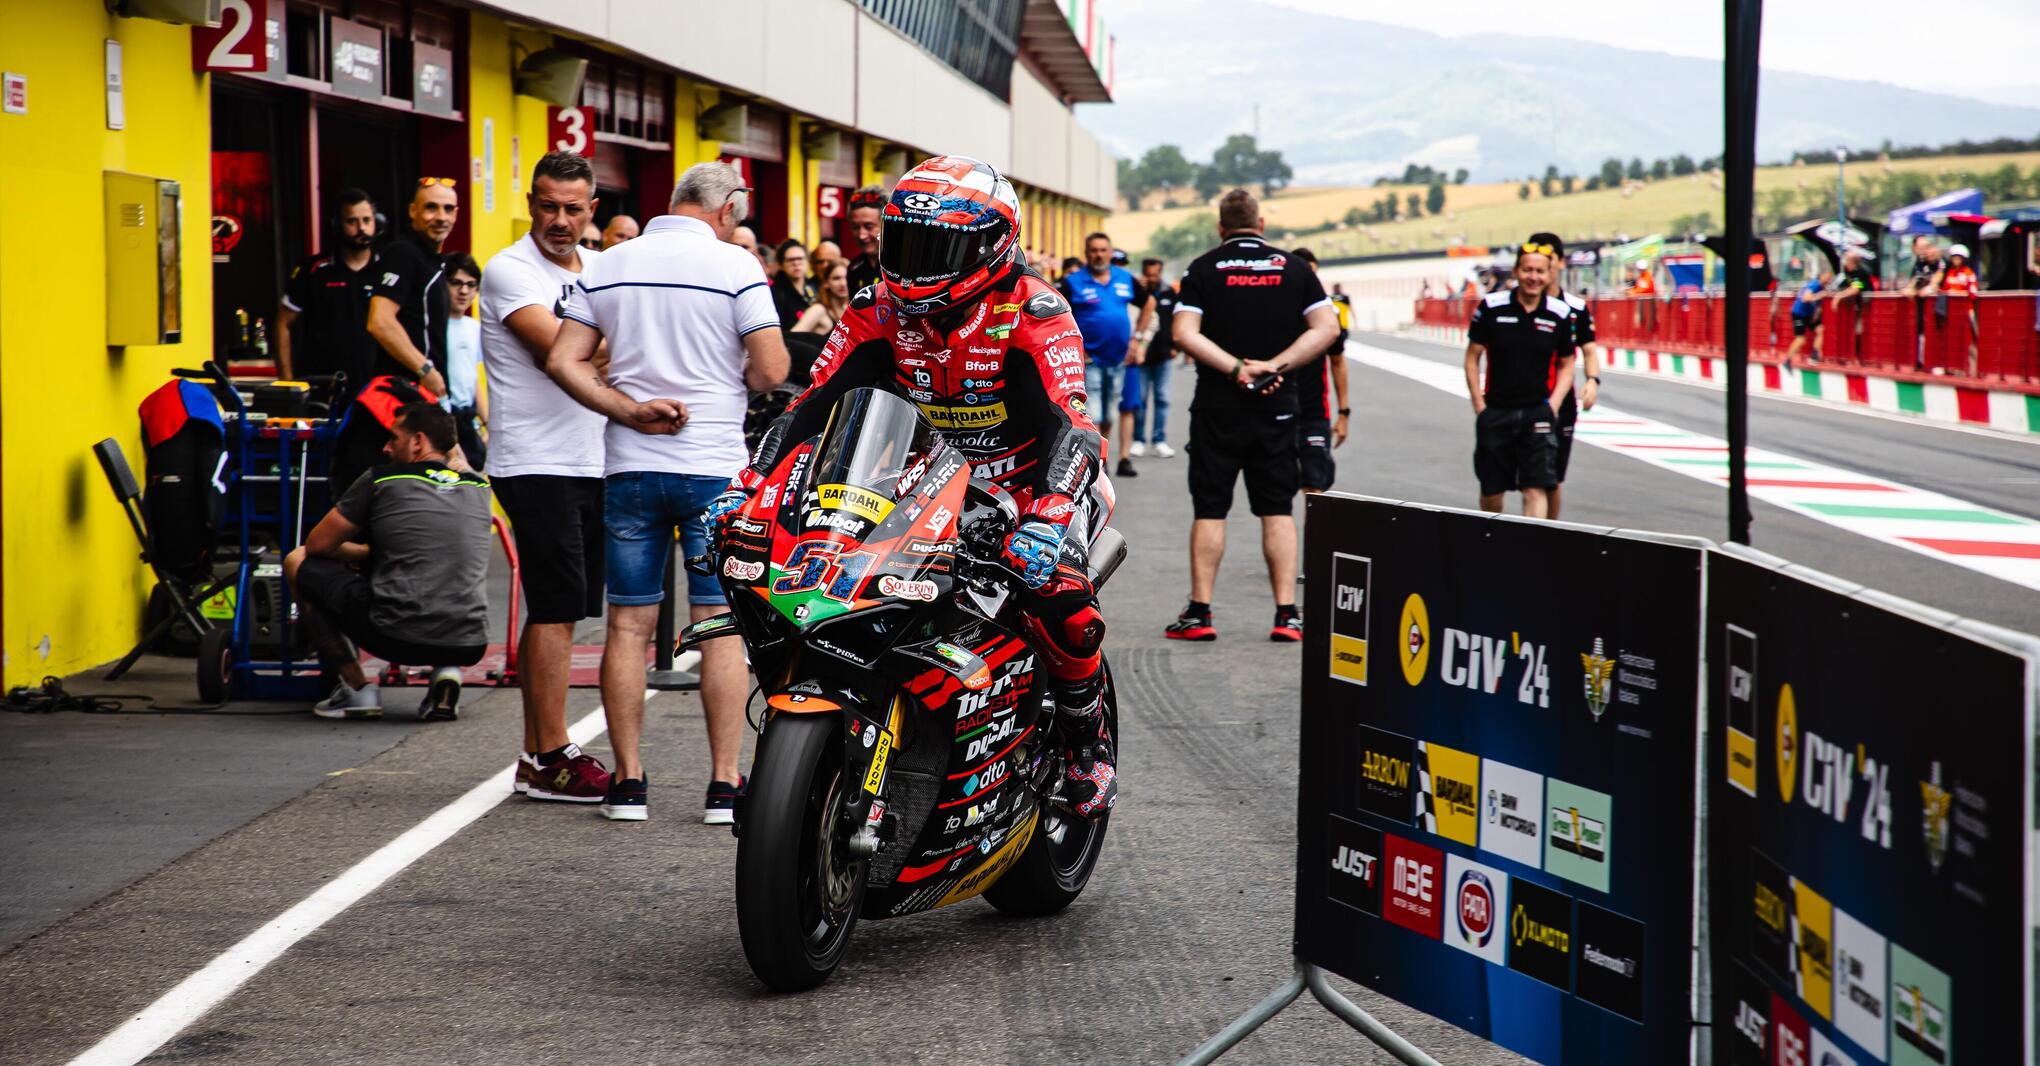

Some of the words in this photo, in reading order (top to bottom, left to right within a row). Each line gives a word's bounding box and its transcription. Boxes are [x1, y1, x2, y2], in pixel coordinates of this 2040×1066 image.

[206, 0, 254, 68] 2
[556, 107, 587, 155] 3
[820, 187, 840, 217] 5
[1226, 275, 1282, 286] DUCATI
[1046, 330, 1081, 345] MAC
[965, 361, 999, 371] BforB
[975, 380, 993, 388] dto
[930, 409, 1001, 426] BARDAHL
[786, 453, 809, 491] PARK
[897, 457, 926, 497] WRS
[823, 489, 881, 512] BARDAHL
[732, 519, 764, 533] DUCATI
[805, 510, 866, 534] Unibat
[925, 505, 954, 537] YSS
[911, 543, 954, 553] DUCATI
[725, 558, 762, 579] SOVERINI
[772, 540, 879, 604] 51
[884, 577, 934, 600] SOVERINI
[1512, 631, 1550, 709] '24
[869, 737, 889, 787] DUNLOP
[980, 761, 1006, 789] dto
[1361, 750, 1411, 789] ARROW
[1436, 775, 1475, 813] BARDAHL
[1857, 743, 1893, 849] '24
[1527, 919, 1569, 953] XLMOTO
